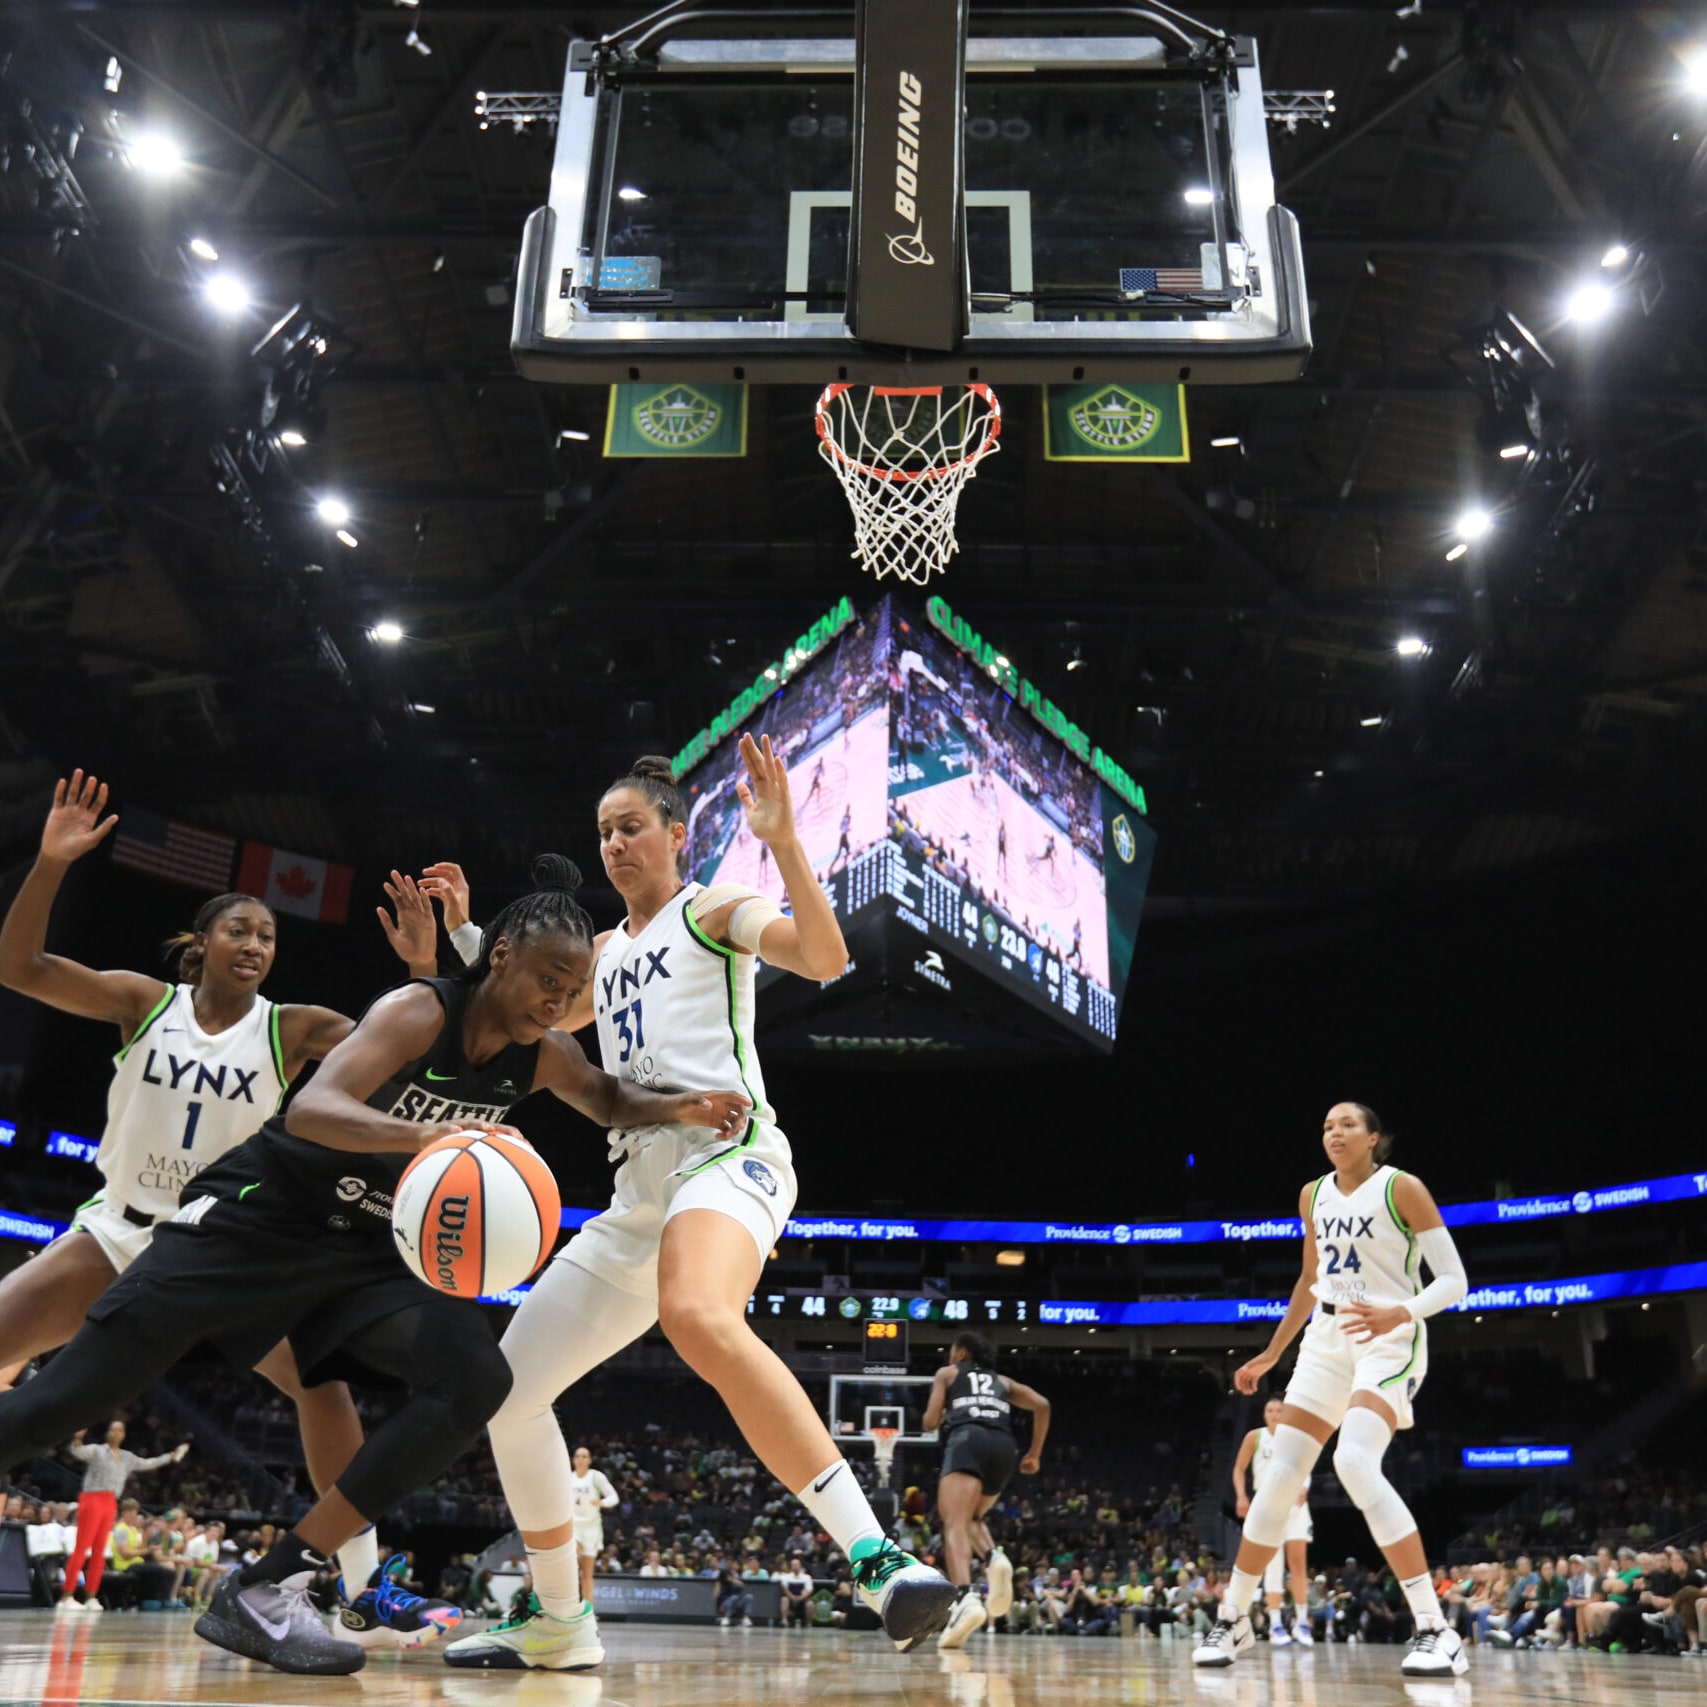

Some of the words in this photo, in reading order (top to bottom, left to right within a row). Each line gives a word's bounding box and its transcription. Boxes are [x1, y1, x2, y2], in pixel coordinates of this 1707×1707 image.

[895, 71, 922, 224] BOEING
[1020, 677, 1090, 764] PLEDGE
[1091, 747, 1148, 815] ARENA
[598, 946, 672, 1014] YNX
[612, 998, 645, 1062] 31
[142, 1048, 259, 1104] LYNX
[182, 1101, 203, 1150] 1
[360, 1198, 393, 1220] SWEDIS
[1497, 1198, 1571, 1218] Providence
[1594, 1186, 1649, 1207] SWEDISH
[436, 1194, 470, 1292] Wilson
[786, 1219, 857, 1238] Together,
[860, 1222, 885, 1237] for
[885, 1225, 919, 1240] you.
[1045, 1225, 1111, 1241] Providence
[1132, 1226, 1183, 1241] SWEDISH
[1221, 1222, 1298, 1241] Together,
[1324, 1243, 1361, 1275] 24
[801, 1296, 826, 1316] 44
[943, 1299, 968, 1319] 48
[1451, 1285, 1521, 1312] gether,
[1524, 1284, 1552, 1304] for
[1554, 1283, 1593, 1305] you.
[1064, 1307, 1100, 1323] you.
[967, 1372, 995, 1396] 12
